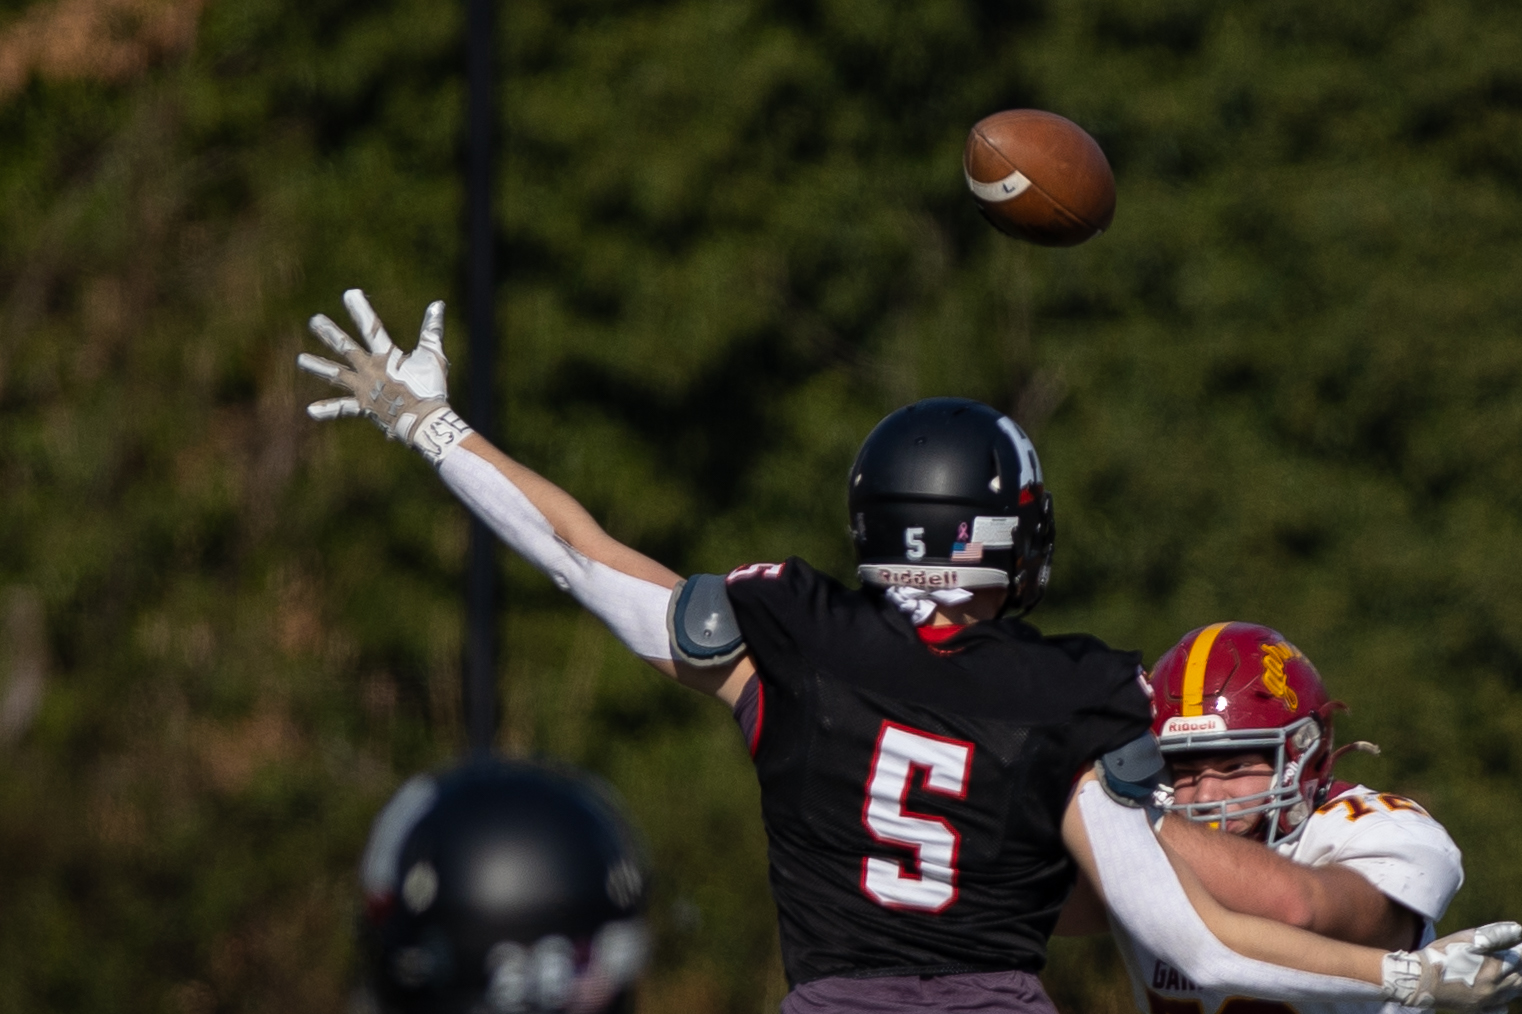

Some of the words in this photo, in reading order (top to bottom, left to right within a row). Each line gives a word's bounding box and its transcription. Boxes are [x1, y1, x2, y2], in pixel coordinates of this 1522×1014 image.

[904, 526, 927, 561] 5
[878, 567, 960, 588] Riddell
[859, 718, 976, 917] 5
